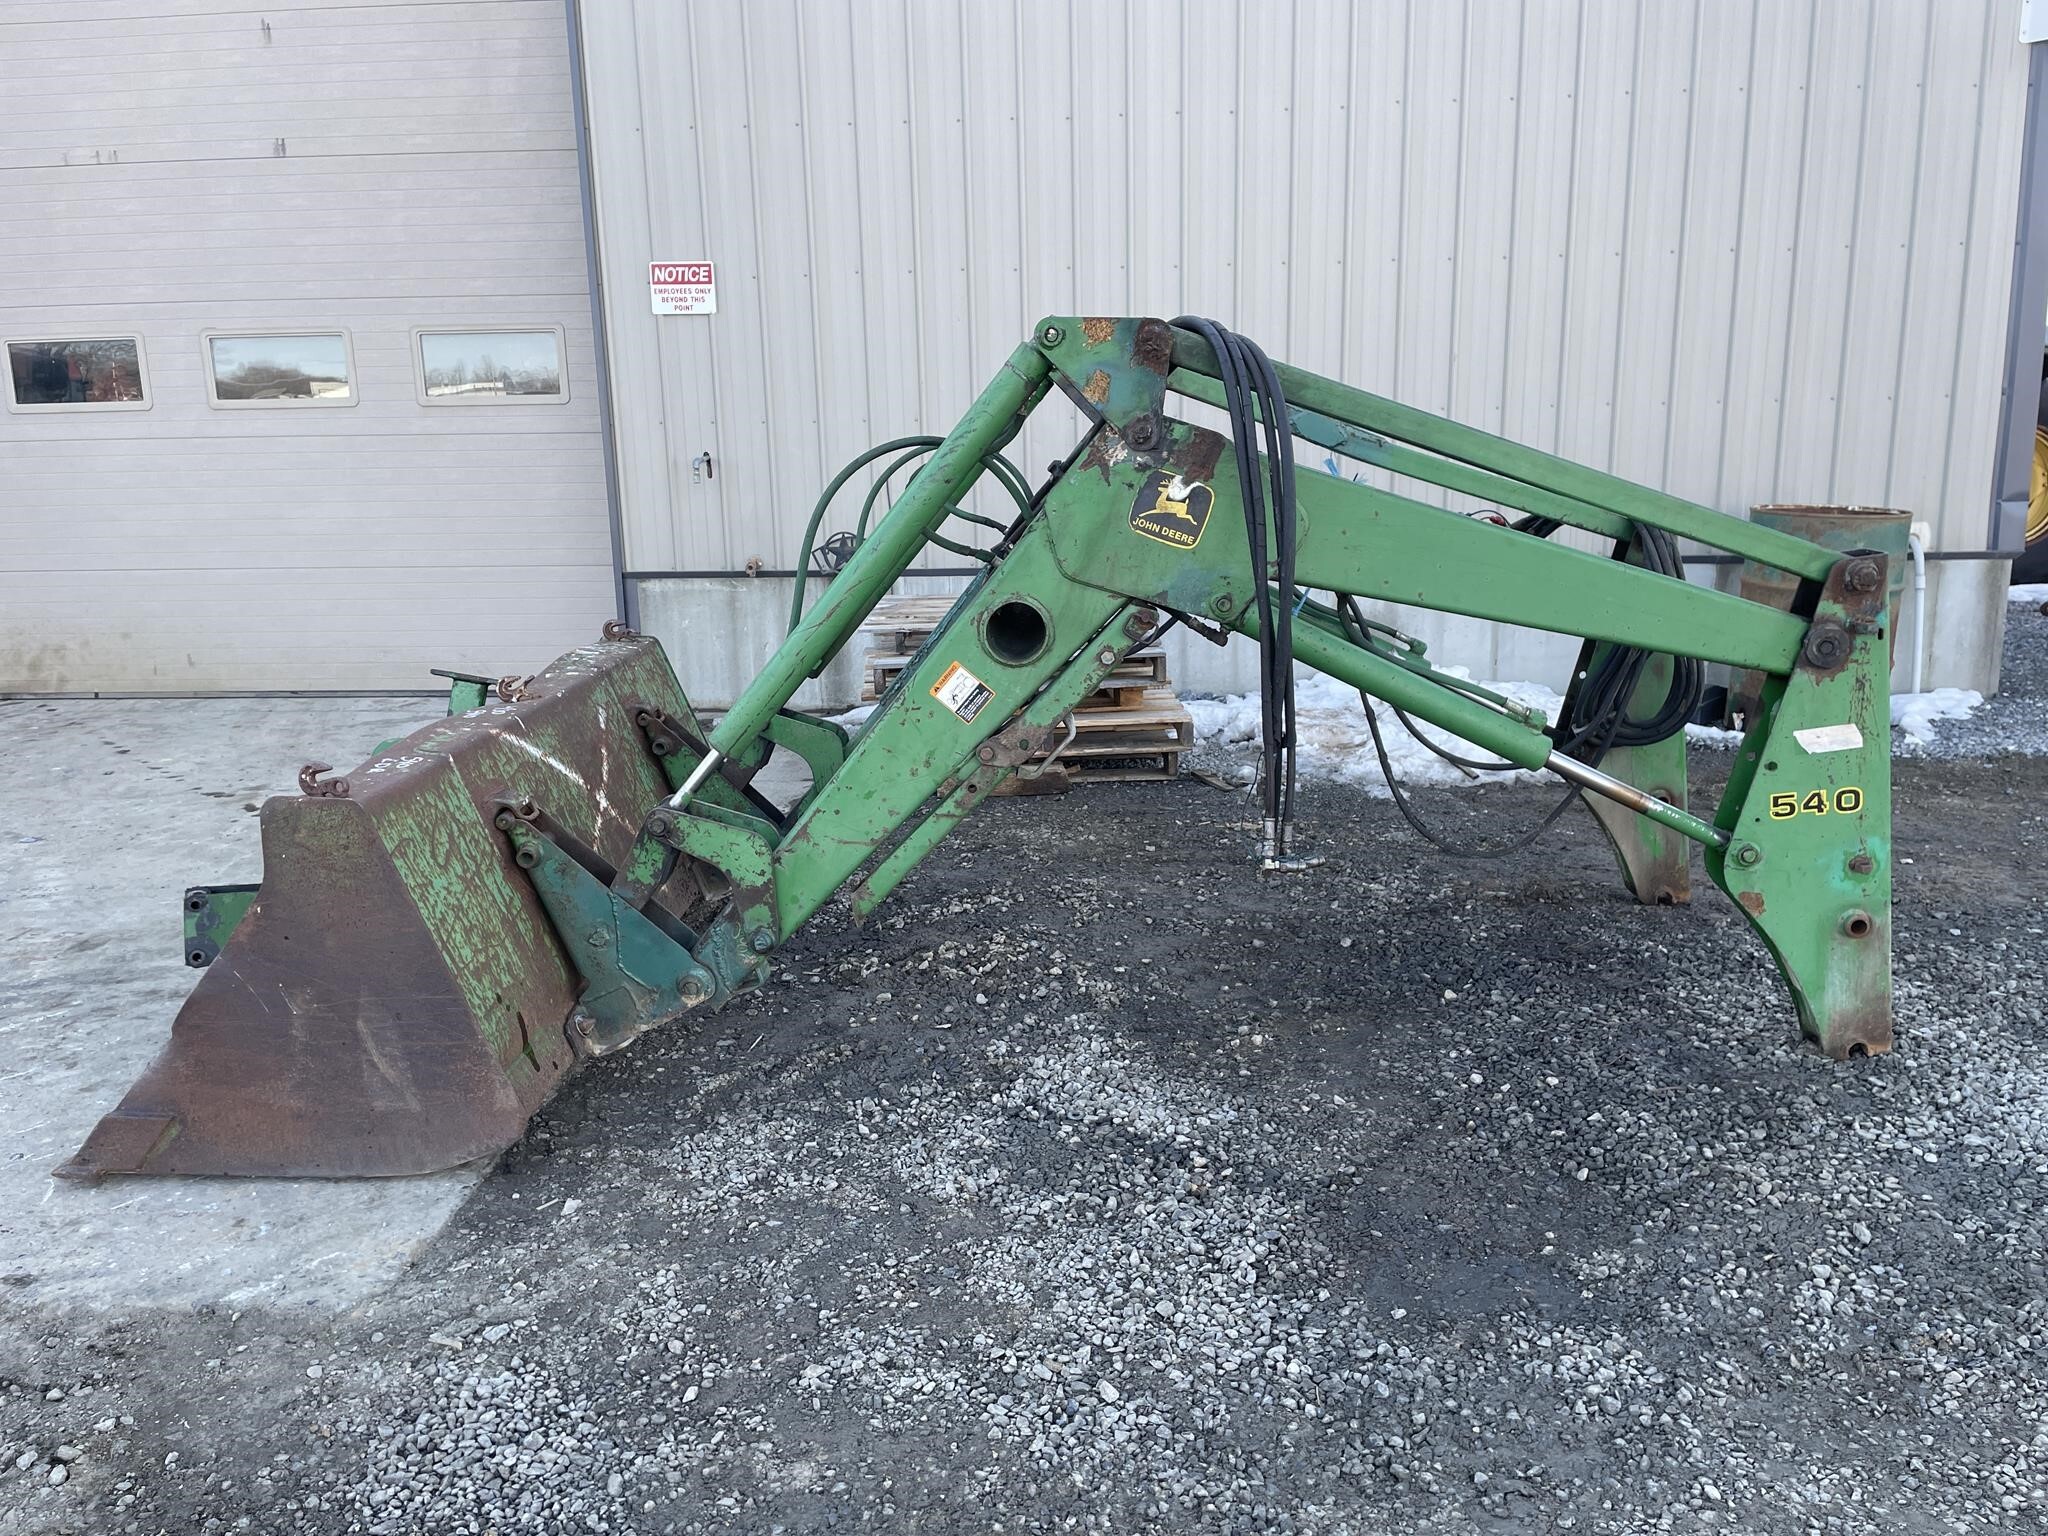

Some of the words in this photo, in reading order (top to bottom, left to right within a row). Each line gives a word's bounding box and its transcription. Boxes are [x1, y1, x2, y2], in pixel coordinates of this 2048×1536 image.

[653, 266, 710, 282] NOTICE
[1132, 517, 1160, 533] JOHN
[1161, 526, 1195, 545] DEERE
[1769, 786, 1863, 820] 540
